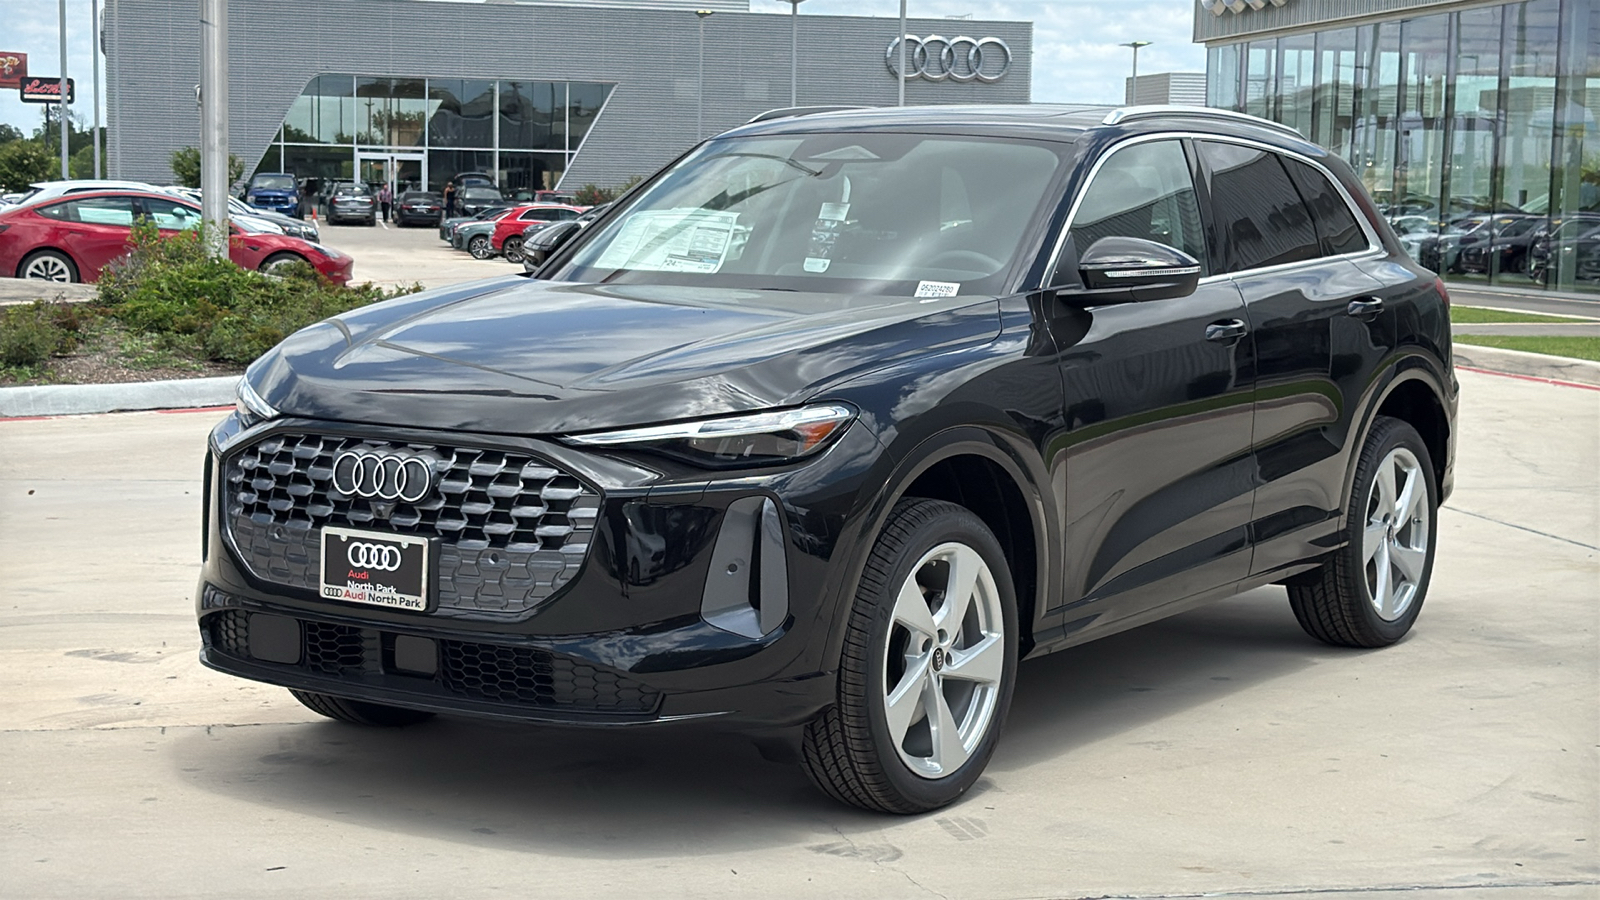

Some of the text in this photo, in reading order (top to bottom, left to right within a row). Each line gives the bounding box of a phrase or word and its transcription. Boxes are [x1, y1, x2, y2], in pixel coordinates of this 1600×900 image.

[347, 569, 369, 580] Audi
[347, 580, 397, 595] North Park
[343, 589, 421, 608] Audi North Park
